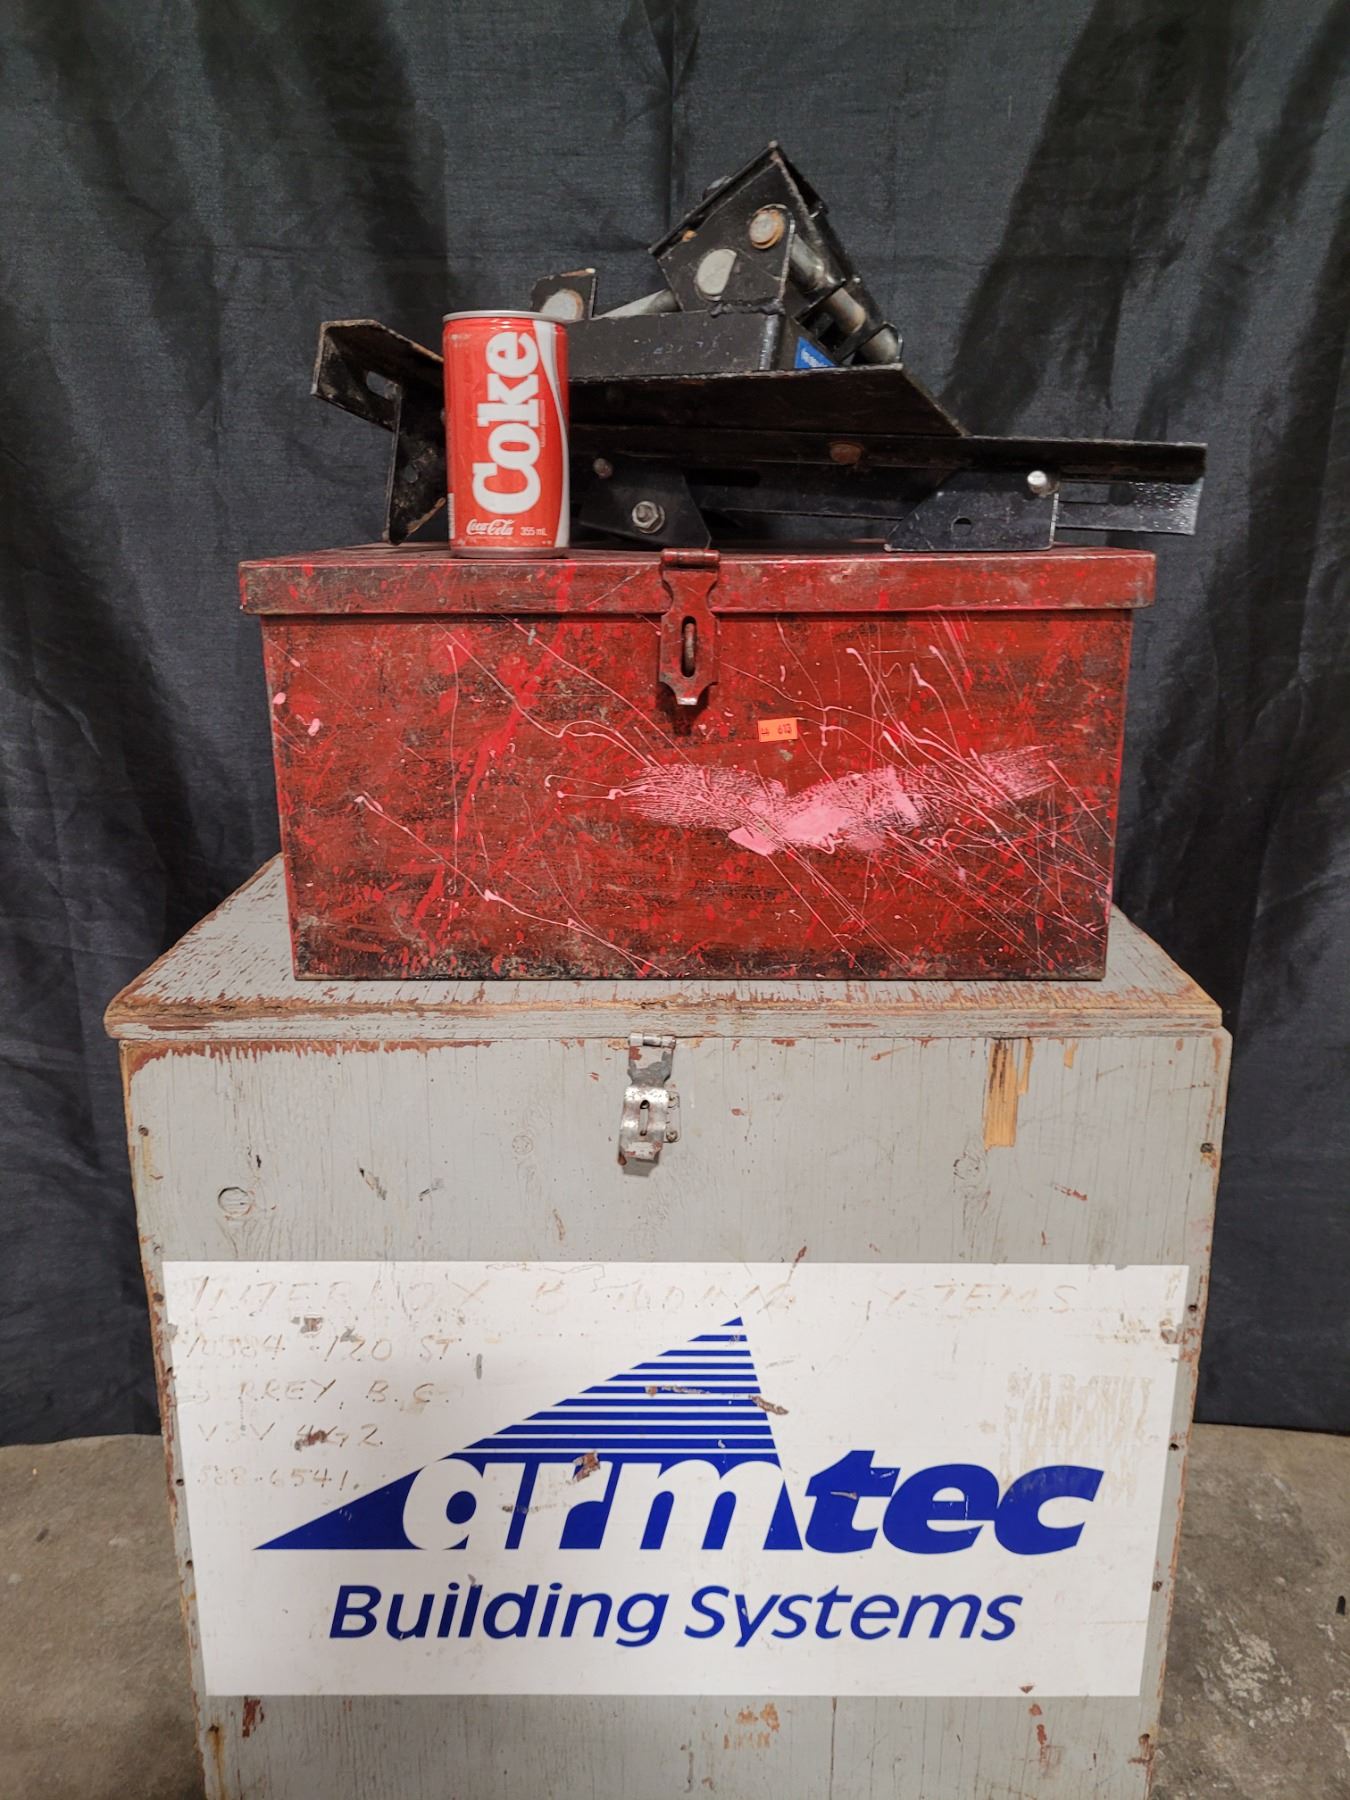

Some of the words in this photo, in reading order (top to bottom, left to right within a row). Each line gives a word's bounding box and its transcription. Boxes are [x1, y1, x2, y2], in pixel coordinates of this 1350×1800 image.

[472, 331, 542, 515] Coke
[402, 1450, 1104, 1555] armtec
[331, 1583, 669, 1648] Building
[684, 1585, 1023, 1647] Systems
